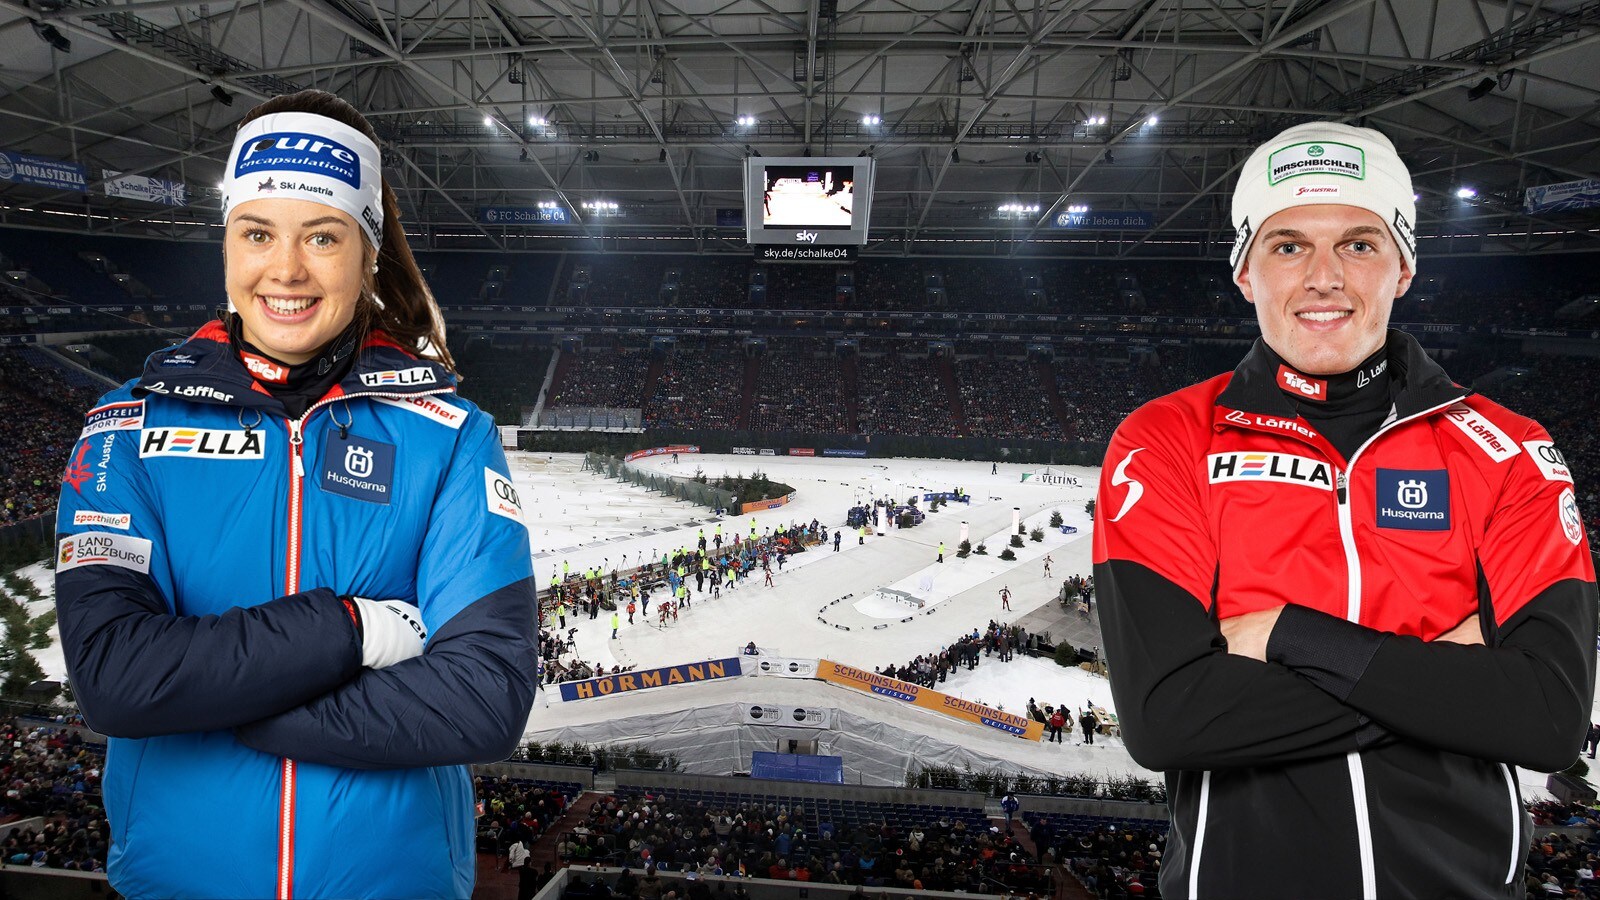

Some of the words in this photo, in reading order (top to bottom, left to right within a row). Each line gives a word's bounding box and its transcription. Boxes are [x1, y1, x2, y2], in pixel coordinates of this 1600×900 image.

[243, 137, 354, 164] pure
[15, 164, 85, 184] MONASTERIA
[240, 157, 353, 178] encapsulations
[1273, 159, 1360, 176] HIRSCHBICHLER
[120, 181, 149, 193] Schalke
[279, 181, 296, 190] Ski
[299, 183, 334, 197] Austria
[500, 211, 512, 221] FC
[514, 210, 551, 221] Schalke
[553, 211, 565, 221] 04
[1072, 216, 1091, 226] Wir
[1093, 215, 1120, 226] leben
[796, 230, 818, 244] sky
[764, 248, 848, 259] sky.de/schalke04
[365, 369, 433, 384] HELLA
[173, 385, 234, 402] Löffler
[88, 408, 132, 424] POLIZEI
[86, 418, 119, 434] SPORT
[1256, 417, 1317, 438] Löffler
[142, 430, 262, 455] HELLA
[1466, 419, 1507, 453] Löffler
[98, 433, 116, 469] Austria
[1211, 455, 1330, 485] HELLA
[96, 472, 106, 492] Ski
[327, 470, 386, 493] Husqvarna
[1042, 475, 1078, 486] VELTINS
[498, 503, 518, 517] Audi
[1381, 507, 1445, 520] Husqvarna
[75, 513, 121, 525] sporthilfe
[78, 537, 113, 548] LAND
[77, 547, 145, 565] SALZBURG
[575, 661, 726, 699] HÖRMANN
[833, 664, 919, 695] SCHAUINSLAND
[874, 686, 912, 701] REISEN
[943, 696, 1029, 728] SCHAUINSLAND
[983, 718, 1021, 734] REISEN
